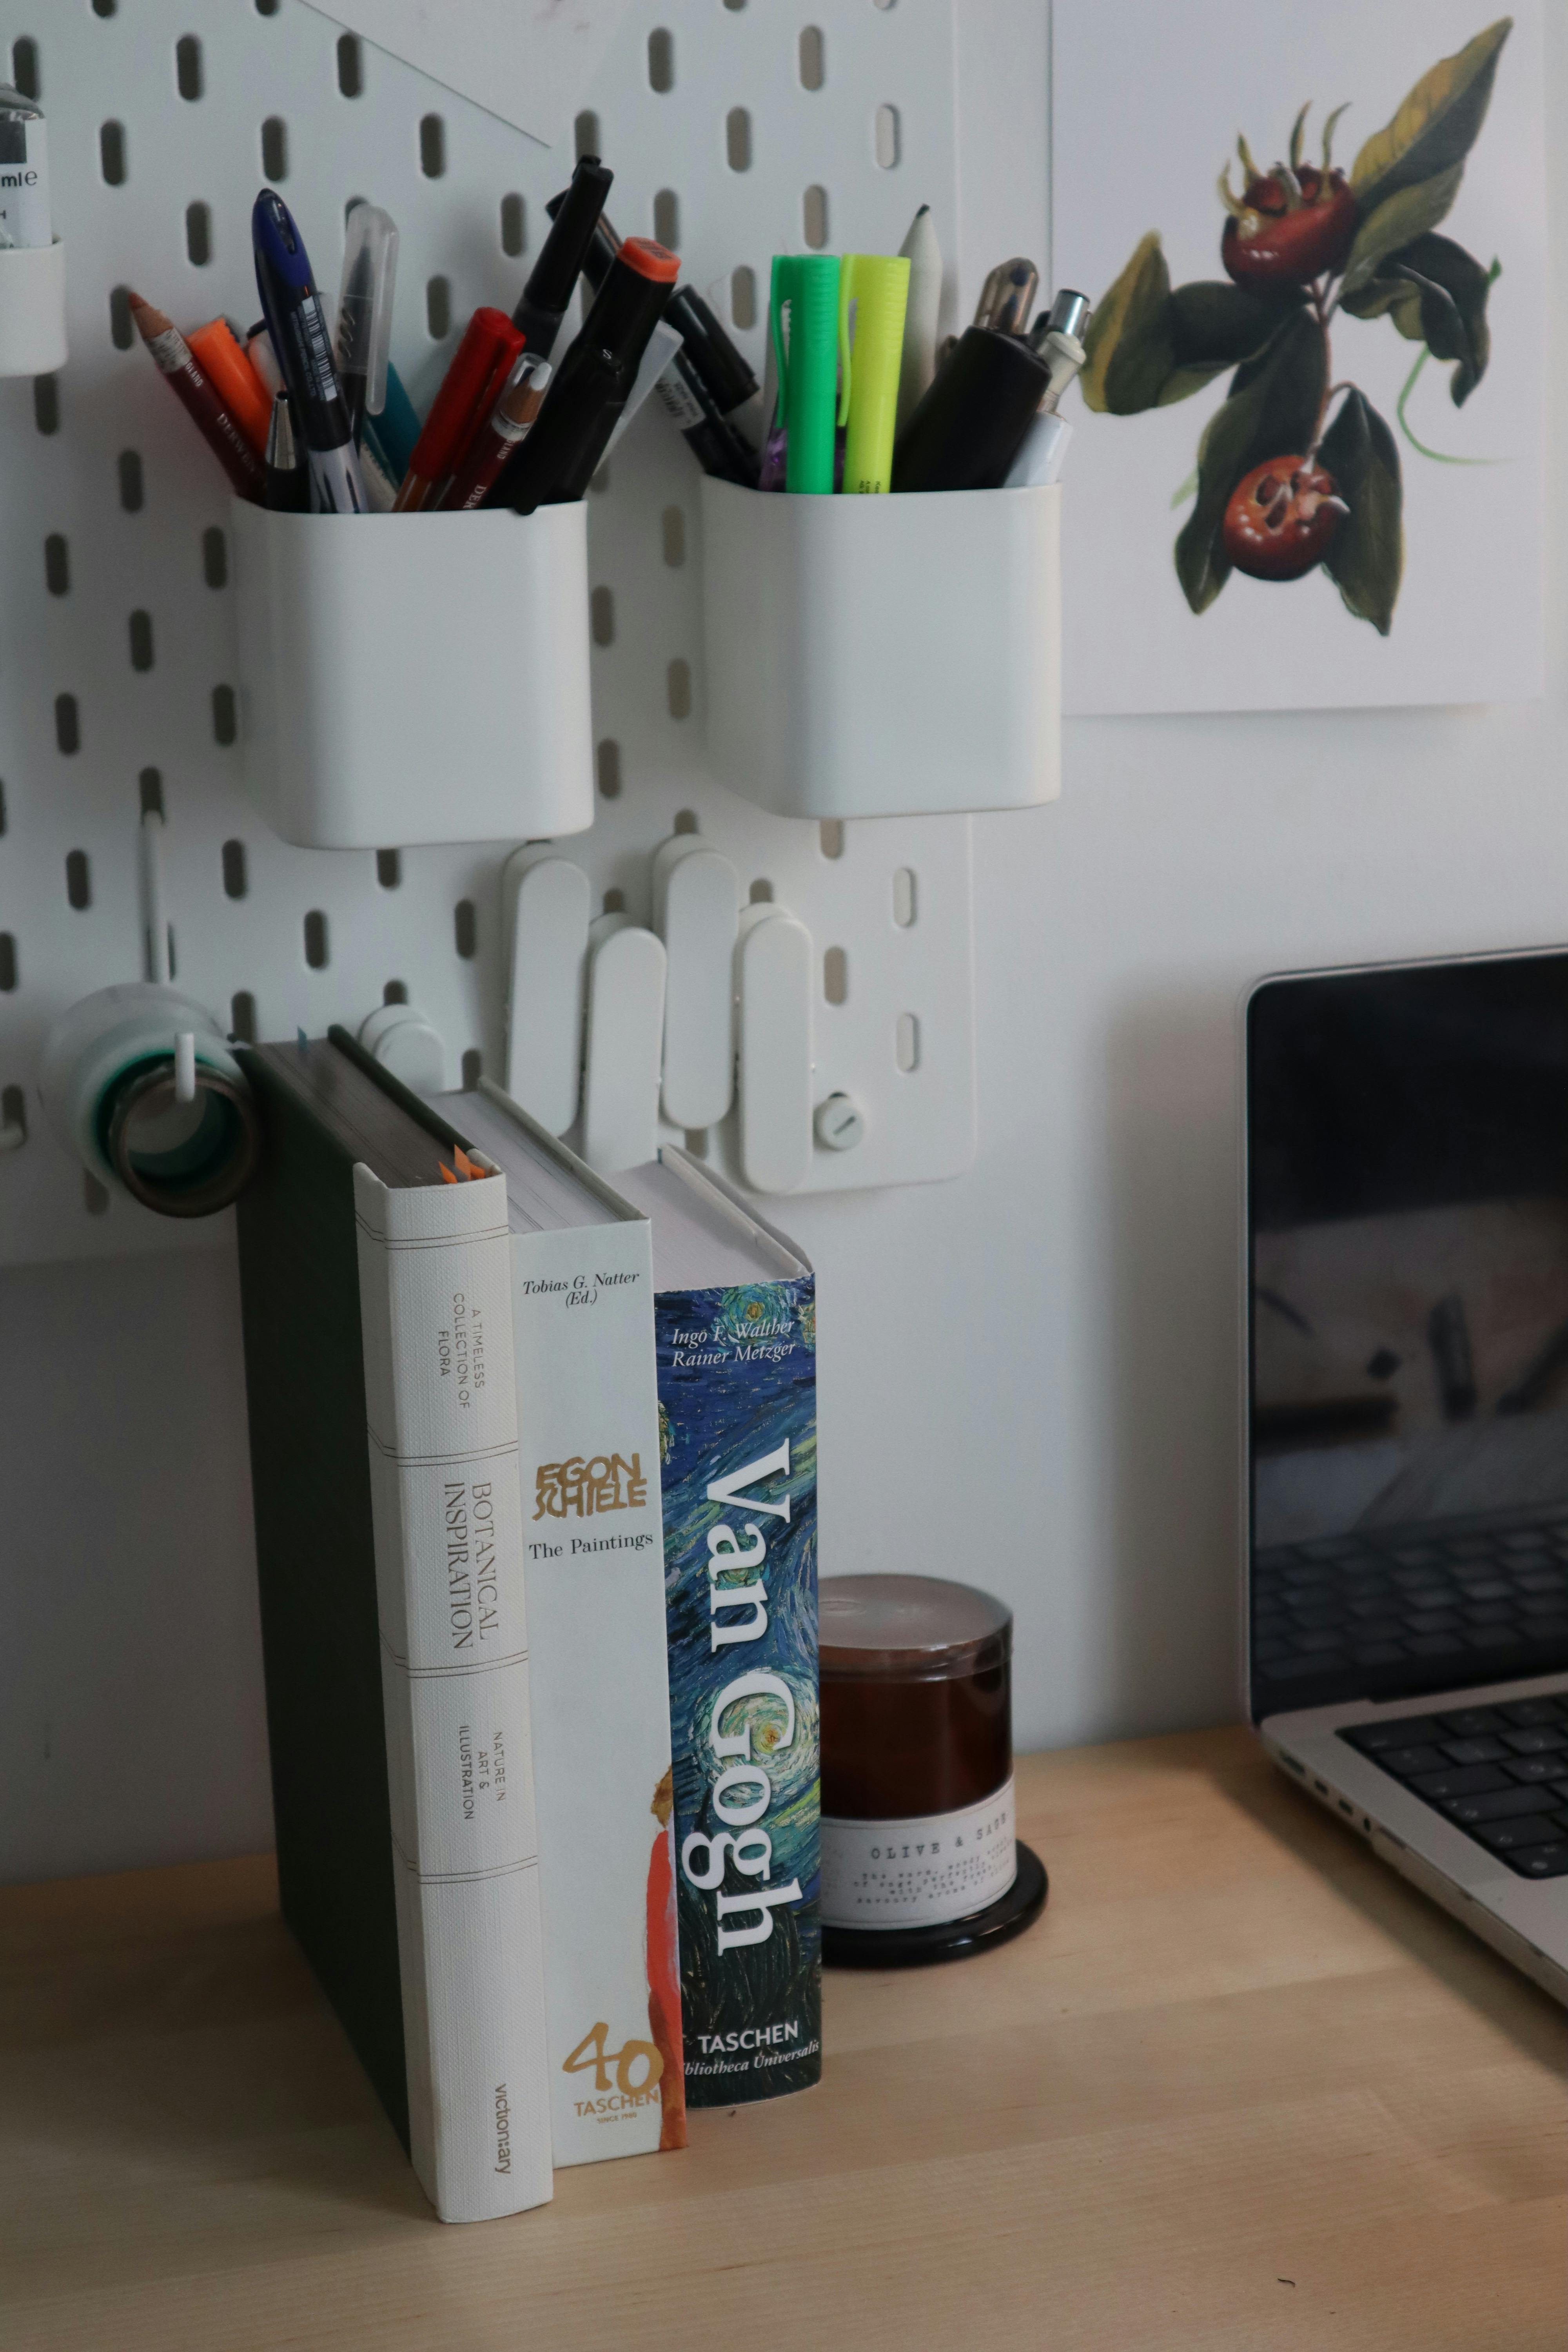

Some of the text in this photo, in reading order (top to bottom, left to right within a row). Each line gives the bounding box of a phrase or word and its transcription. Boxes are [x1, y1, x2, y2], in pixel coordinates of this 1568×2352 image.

[523, 1273, 640, 1294] Tobias G. Natter
[566, 1289, 598, 1308] (Ed.)
[438, 1331, 450, 1376] FLORA
[454, 1293, 470, 1409] COLLECTION OF
[472, 1309, 485, 1388] A TIMELESS
[672, 1319, 795, 1349] Ingo F. Walther
[671, 1342, 796, 1367] Rainer Metzger
[536, 1452, 641, 1490] EGON
[532, 1478, 648, 1521] SCHIELE
[445, 1482, 474, 1649] INSPIRATION
[472, 1482, 499, 1641] BOTANICAL
[529, 1534, 653, 1560] The Paintings
[681, 1437, 804, 1956] Van Gogh
[459, 1726, 474, 1820] ILLUSTRATION
[478, 1751, 489, 1790] ART &
[493, 1731, 506, 1802] NATURE IN
[871, 1843, 940, 1860] OLIVE
[955, 1836, 964, 1848] &
[697, 2020, 799, 2054] TASCHEN
[562, 2022, 664, 2097] 40
[683, 2040, 820, 2076] bliotheca Universalis
[573, 2089, 659, 2116] TASCHEN
